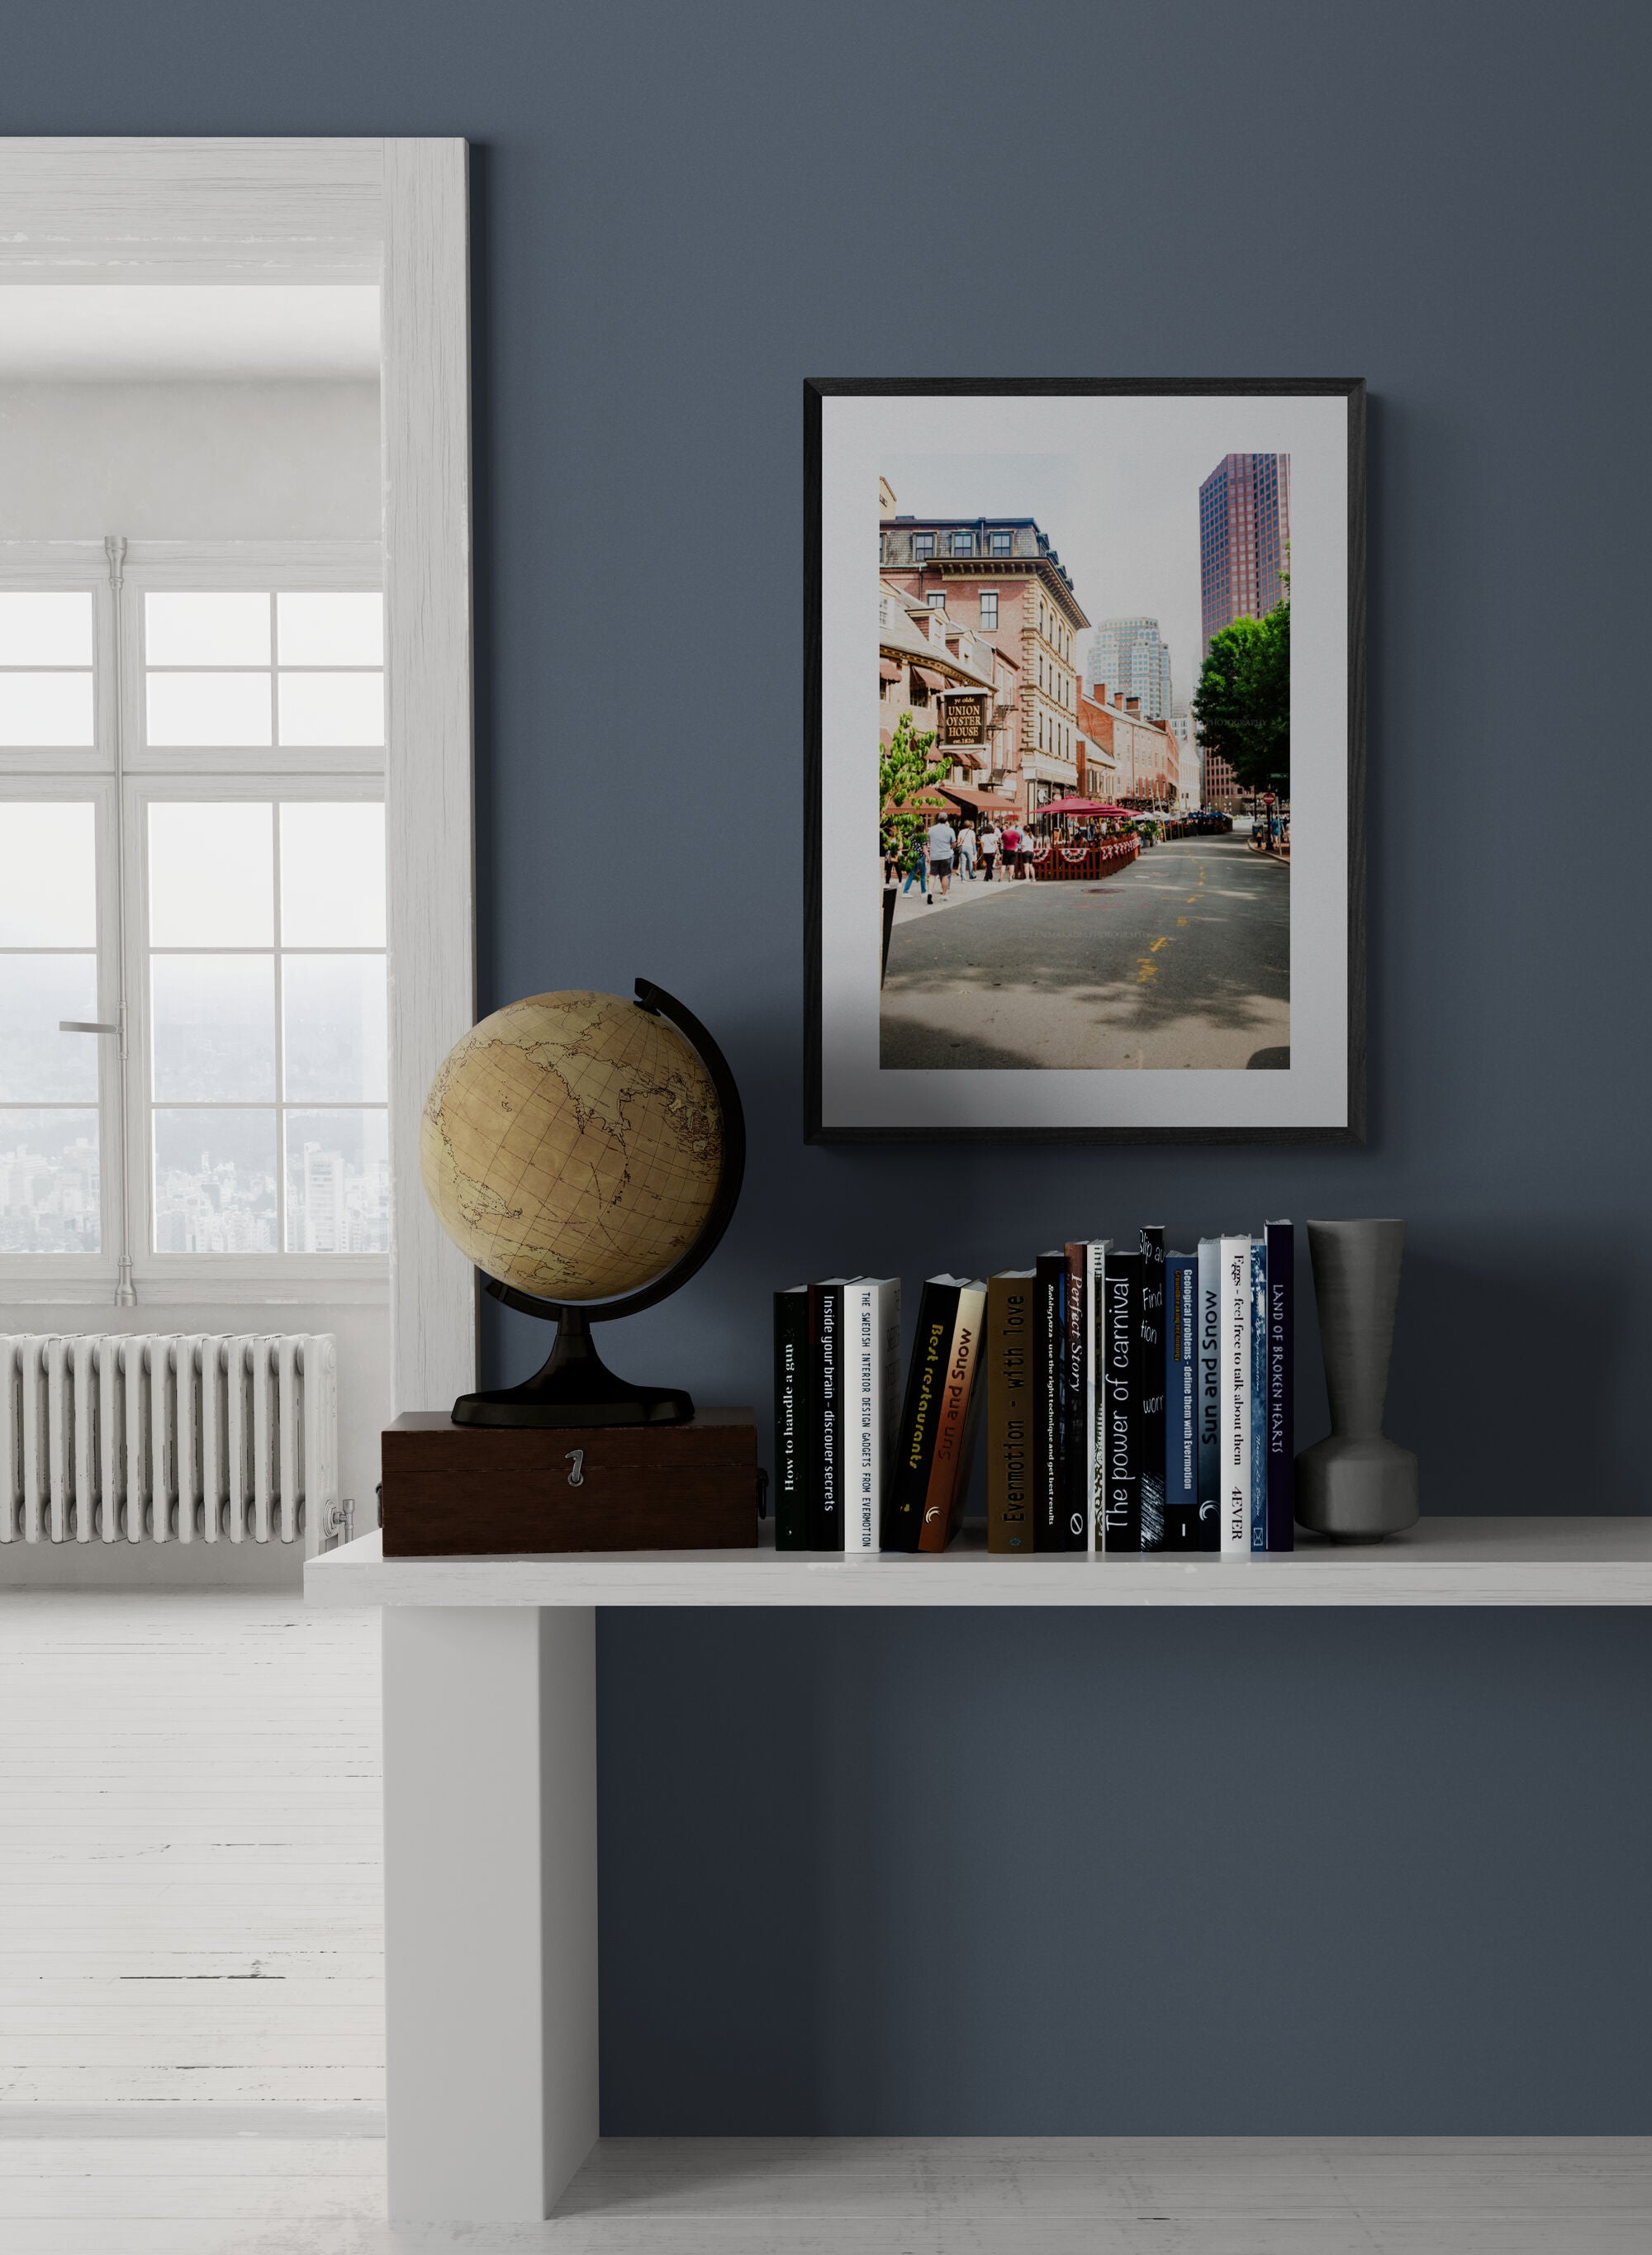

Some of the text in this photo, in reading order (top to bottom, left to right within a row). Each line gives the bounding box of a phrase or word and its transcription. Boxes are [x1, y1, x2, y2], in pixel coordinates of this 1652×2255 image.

[946, 715, 982, 726] OYSTER
[948, 705, 980, 716] UNION
[948, 726, 979, 737] HOUSE
[1231, 1255, 1245, 1287] Eggs
[1142, 1283, 1163, 1312] Find
[1183, 1269, 1193, 1315] Geological
[1234, 1298, 1244, 1321] feel
[824, 1295, 834, 1333] Inside
[1004, 1294, 1025, 1336] love
[1141, 1319, 1157, 1344] tion
[821, 1335, 834, 1365] your
[1070, 1273, 1084, 1393] Perfect Story
[1182, 1317, 1193, 1360] problems
[1234, 1324, 1244, 1349] free
[786, 1343, 795, 1371] gun
[1003, 1346, 1025, 1389] with
[1201, 1289, 1218, 1446] Sun and Snow
[1234, 1352, 1242, 1365] to
[1271, 1284, 1284, 1454] LAND OF BROKEN HEARTS
[824, 1367, 834, 1398] brain
[909, 1323, 944, 1470] Best restaurants
[938, 1327, 972, 1460] Sun and Snow
[1047, 1375, 1055, 1398] right
[1184, 1366, 1193, 1394] define
[1234, 1368, 1244, 1392] talk
[783, 1386, 794, 1436] handle
[862, 1291, 871, 1547] THE SWEDISH INTERIOR DESIGN GADGETS FROM EVERMOTION
[1047, 1398, 1055, 1442] technique
[1105, 1277, 1136, 1532] The power of carnival
[1184, 1395, 1193, 1418] them
[1234, 1394, 1244, 1430] about
[824, 1409, 834, 1465] discover
[1184, 1419, 1193, 1439] with
[785, 1440, 794, 1455] to
[1234, 1433, 1244, 1465] them
[785, 1457, 795, 1492] How
[1003, 1419, 1025, 1523] Evermotion
[1047, 1460, 1055, 1475] get
[1184, 1441, 1193, 1490] Evermotion
[824, 1465, 834, 1512] secrets
[1232, 1486, 1243, 1541] 4EVER
